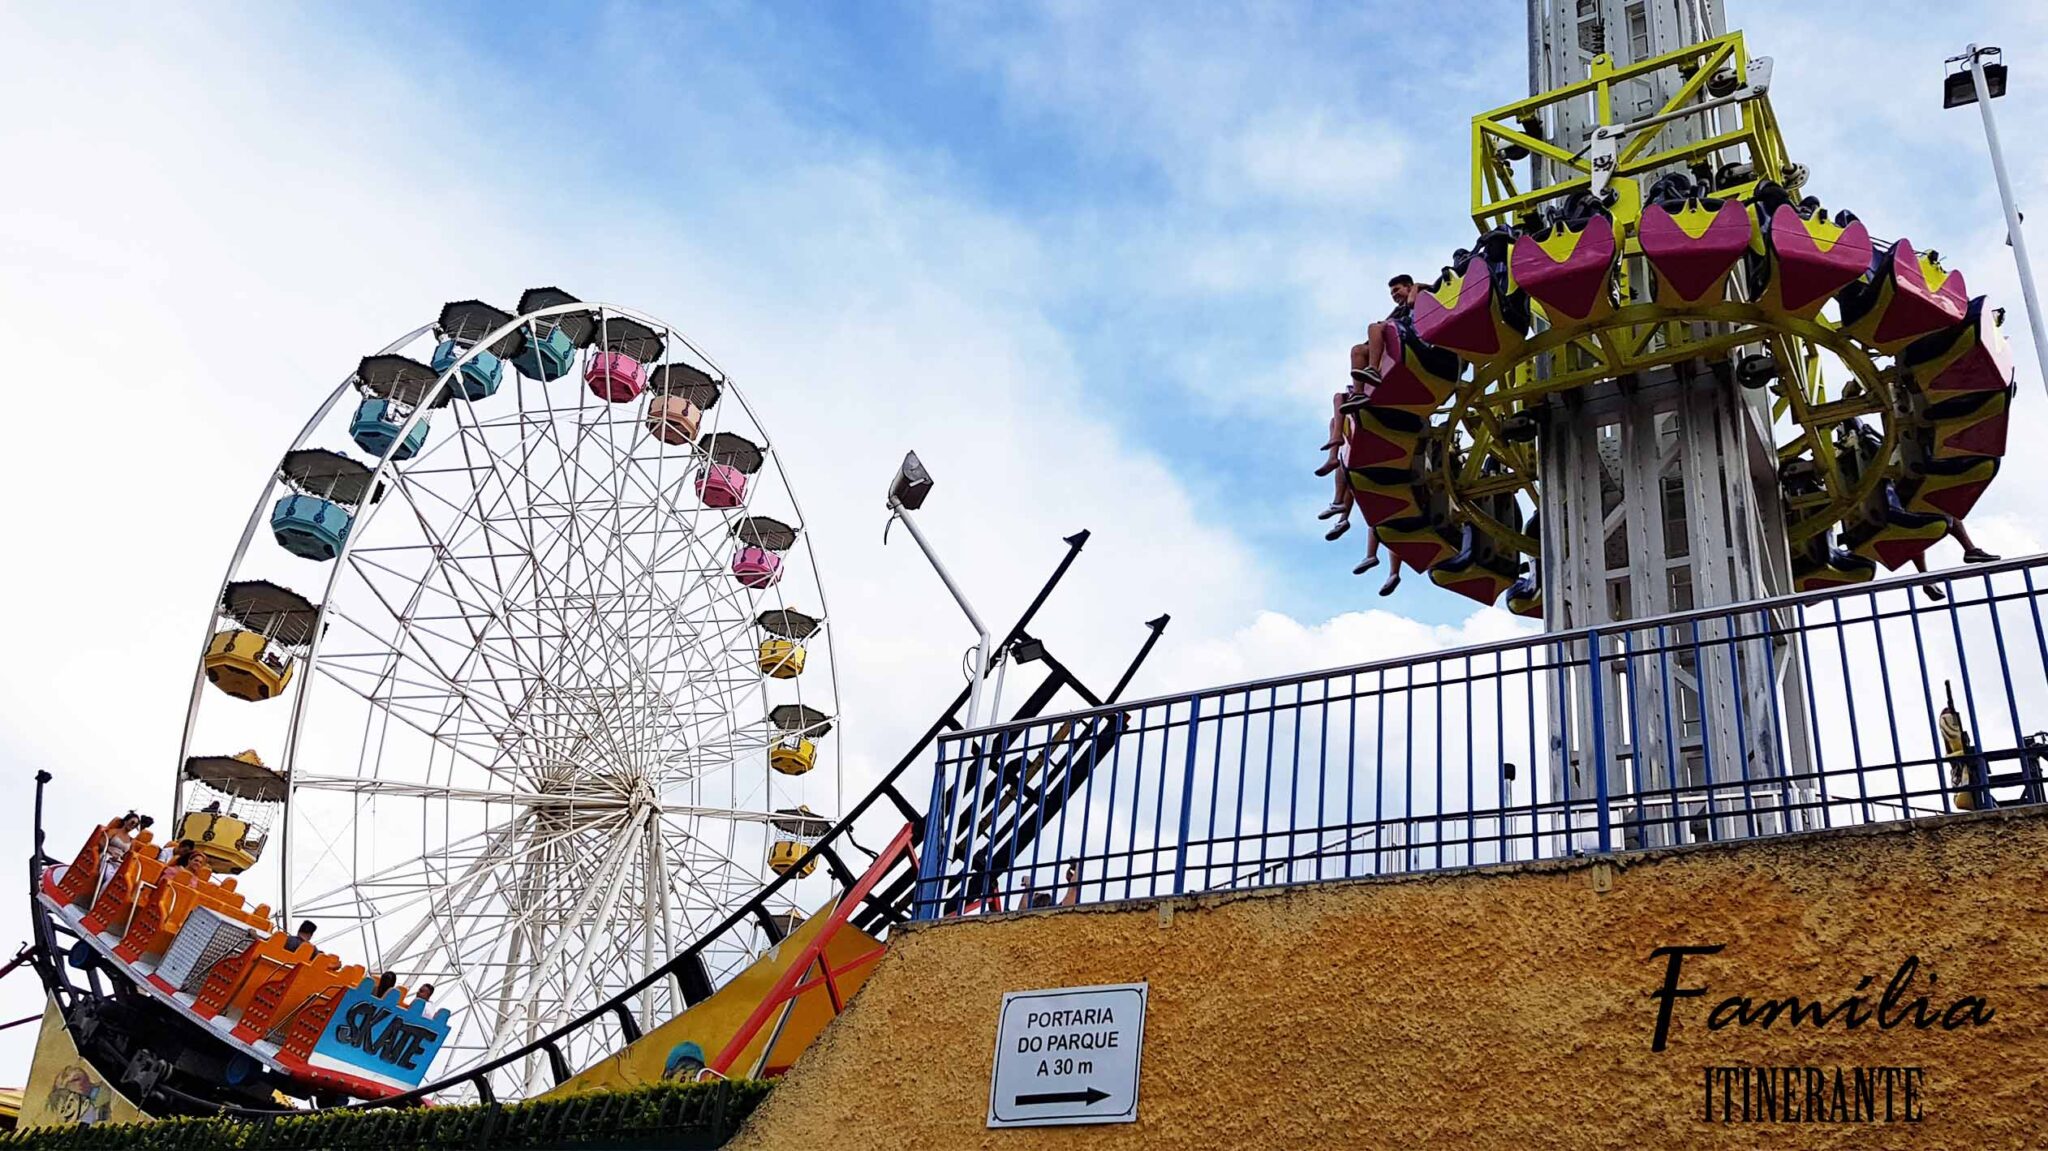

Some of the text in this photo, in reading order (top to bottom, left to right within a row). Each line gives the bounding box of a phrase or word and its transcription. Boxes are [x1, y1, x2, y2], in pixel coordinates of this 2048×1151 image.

[1027, 1008, 1113, 1028] PORTARIA
[336, 1001, 438, 1070] SKATE
[1017, 1031, 1118, 1053] DO PARQUE
[1036, 1058, 1093, 1077] A 30 m
